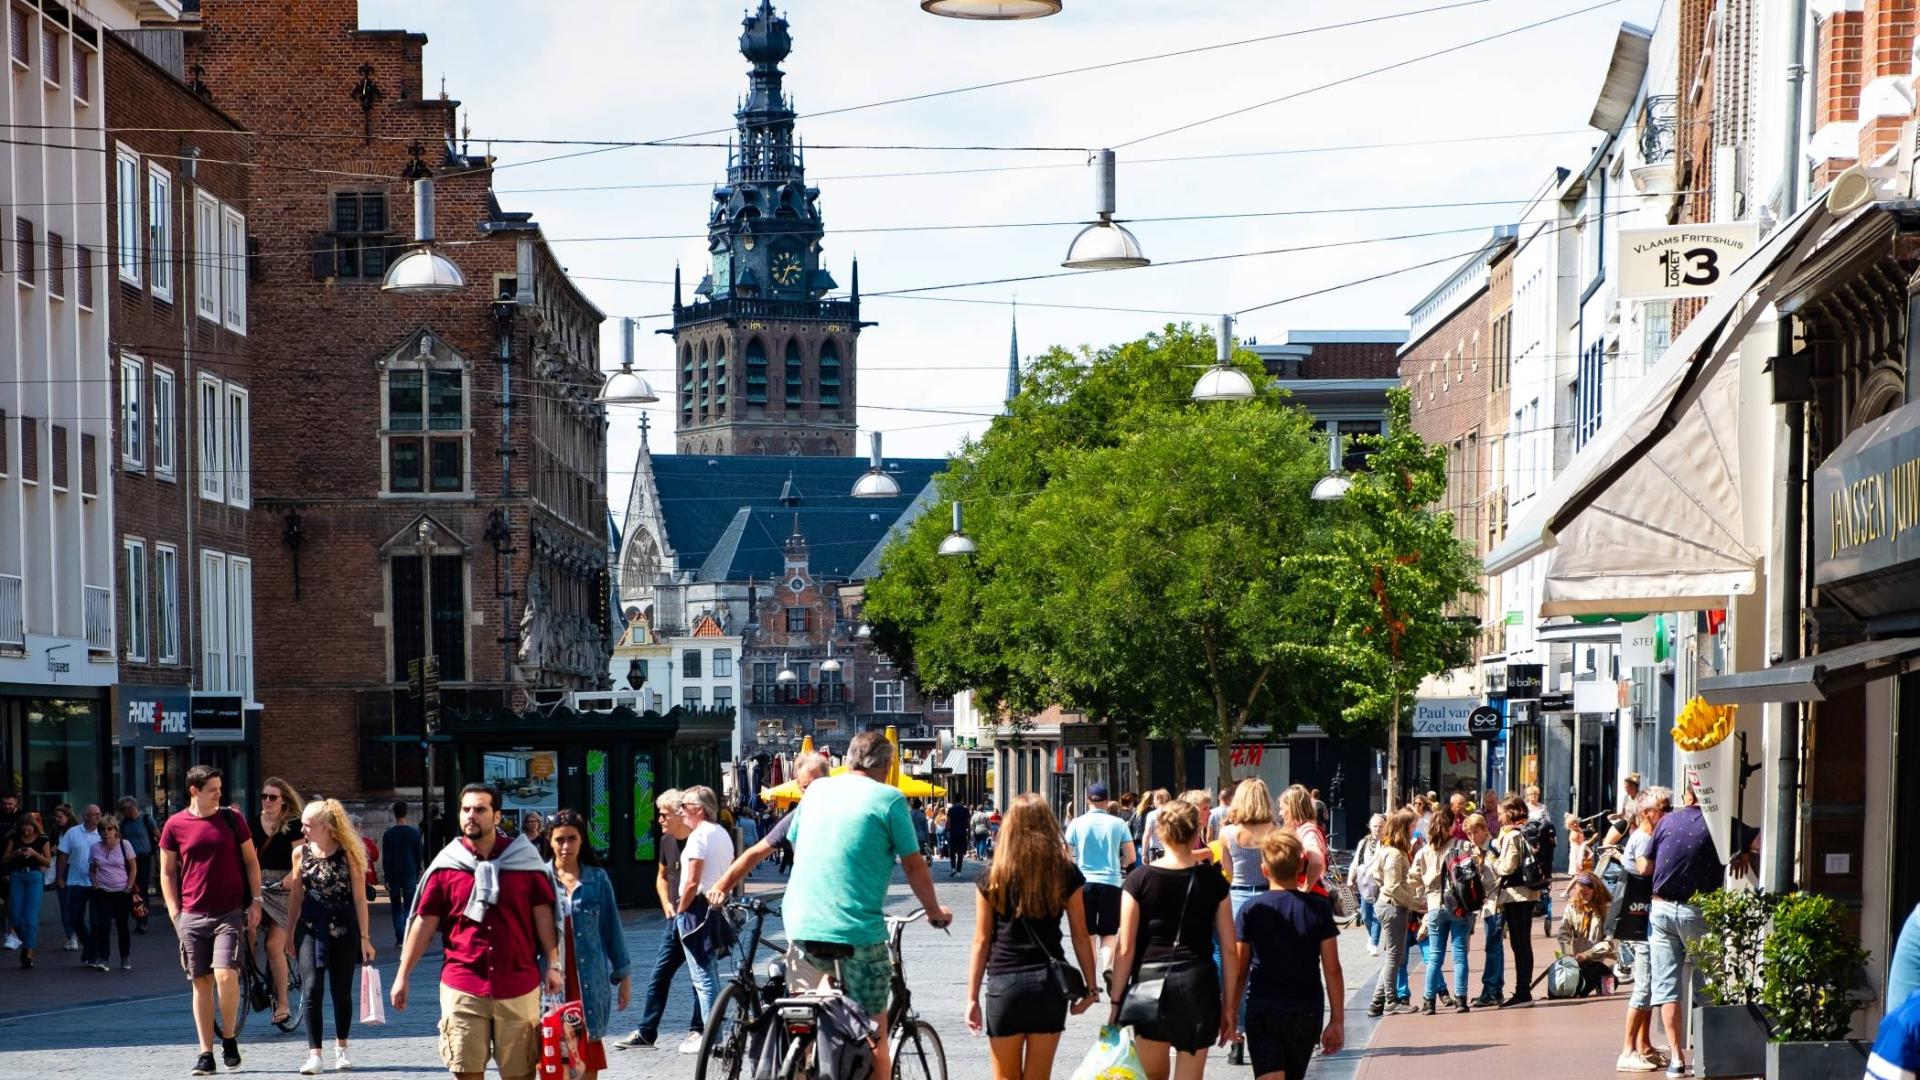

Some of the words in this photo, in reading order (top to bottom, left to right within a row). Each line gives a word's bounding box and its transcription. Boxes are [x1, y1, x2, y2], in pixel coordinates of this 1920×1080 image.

[1633, 236, 1680, 254] VLAAMS
[1681, 233, 1744, 250] FRITESHUIS
[1670, 249, 1680, 287] LOKET
[1830, 472, 1887, 560] JANSSEN
[1508, 676, 1515, 687] le
[129, 701, 157, 723] PHONE
[161, 711, 187, 733] PHONE
[1418, 706, 1446, 719] Paul
[1449, 709, 1470, 719] van
